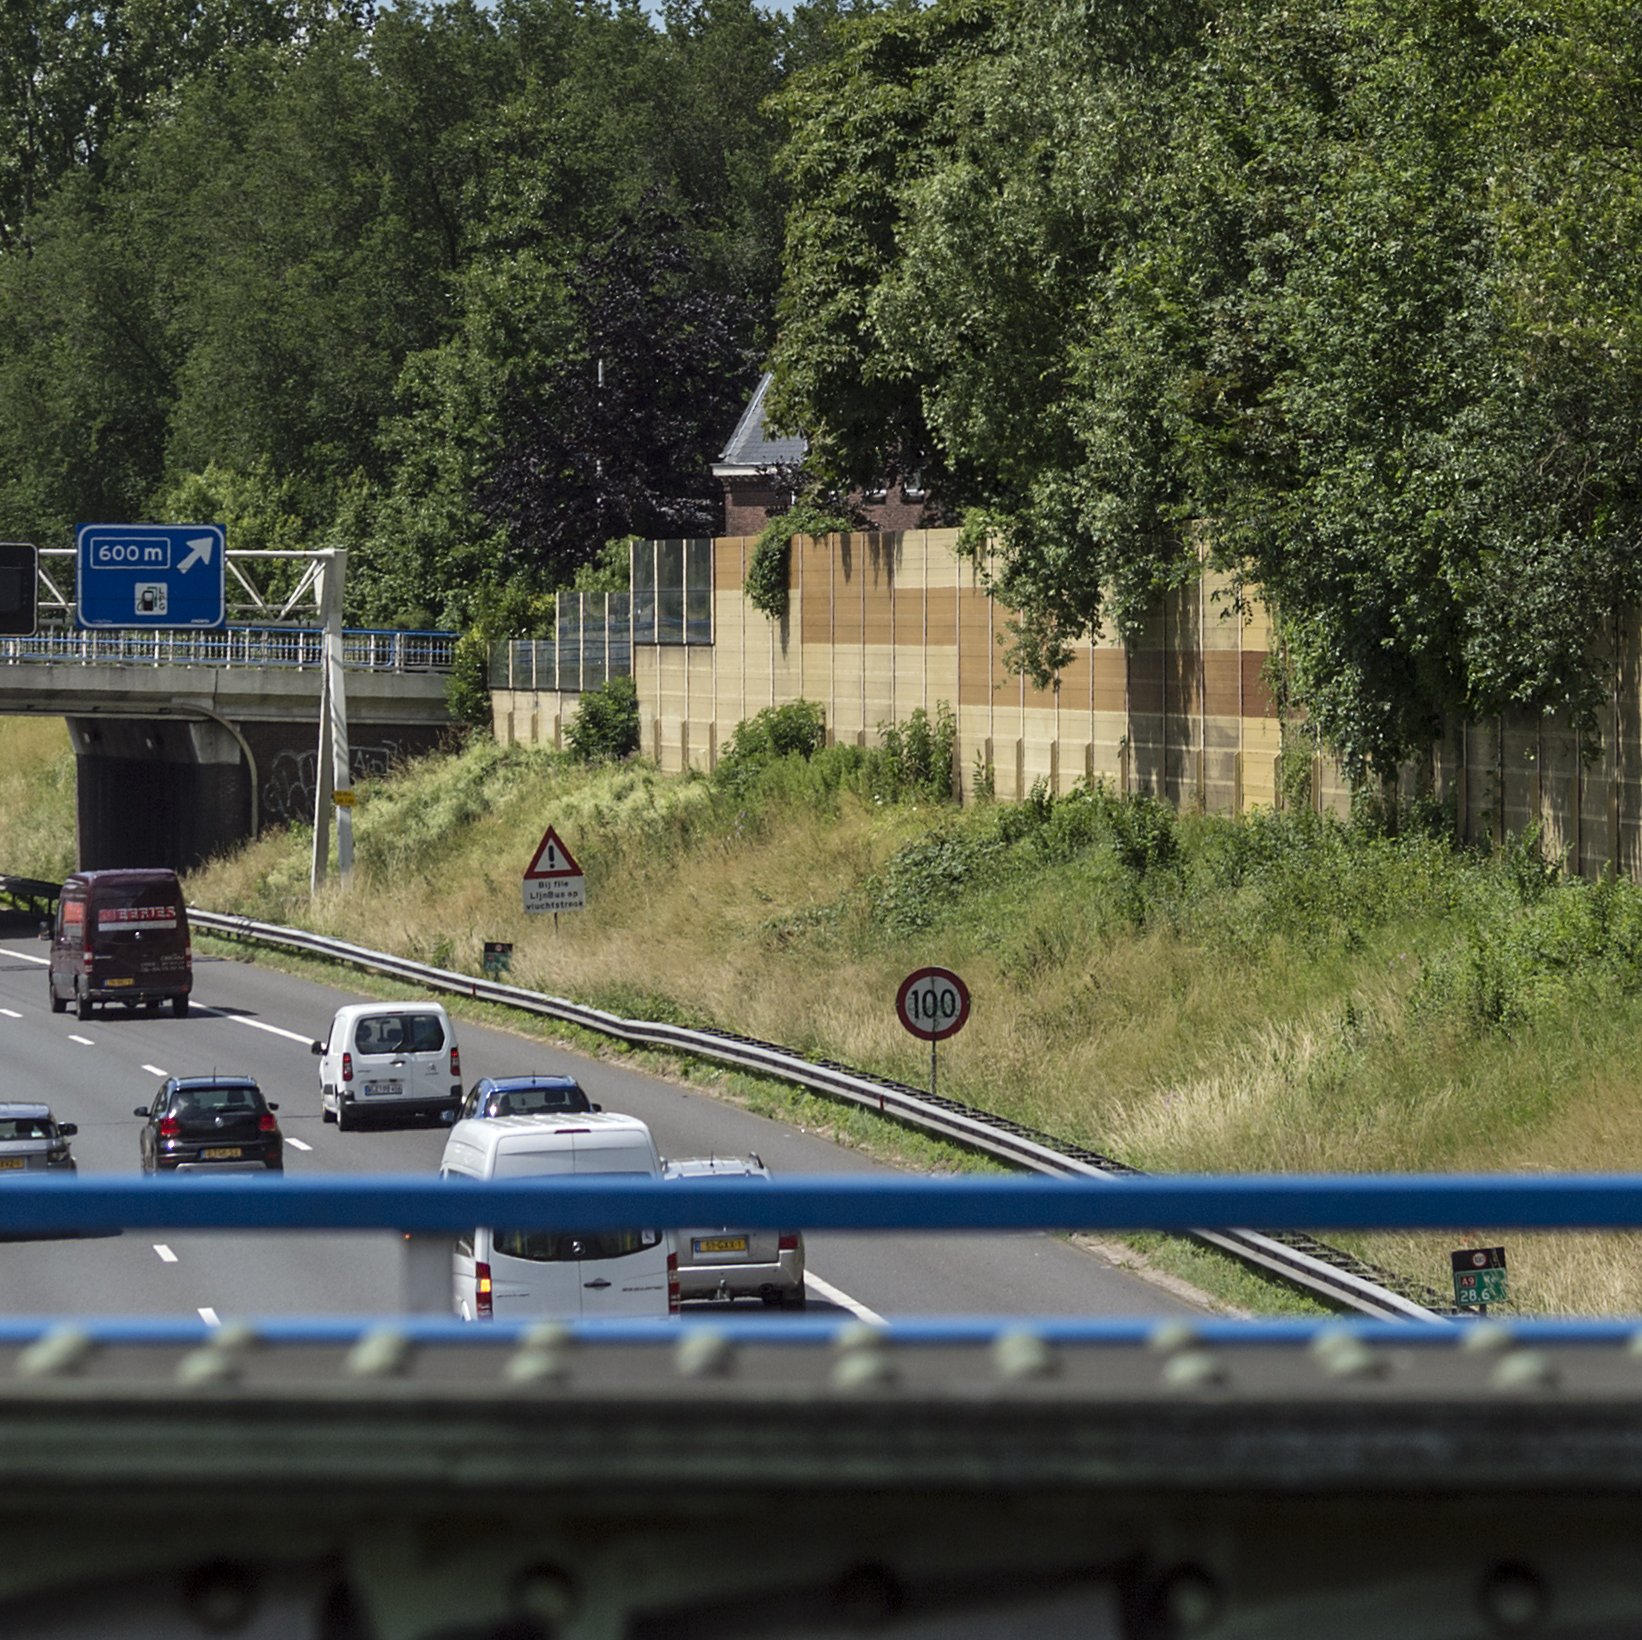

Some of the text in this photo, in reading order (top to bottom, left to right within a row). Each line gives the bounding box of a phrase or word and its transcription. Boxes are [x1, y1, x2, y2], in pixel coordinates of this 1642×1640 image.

[99, 545, 163, 561] 600 m
[158, 586, 166, 611] LPG
[538, 880, 569, 890] Bij file
[567, 891, 579, 899] op
[911, 988, 956, 1020] 100
[1462, 1276, 1475, 1286] A9
